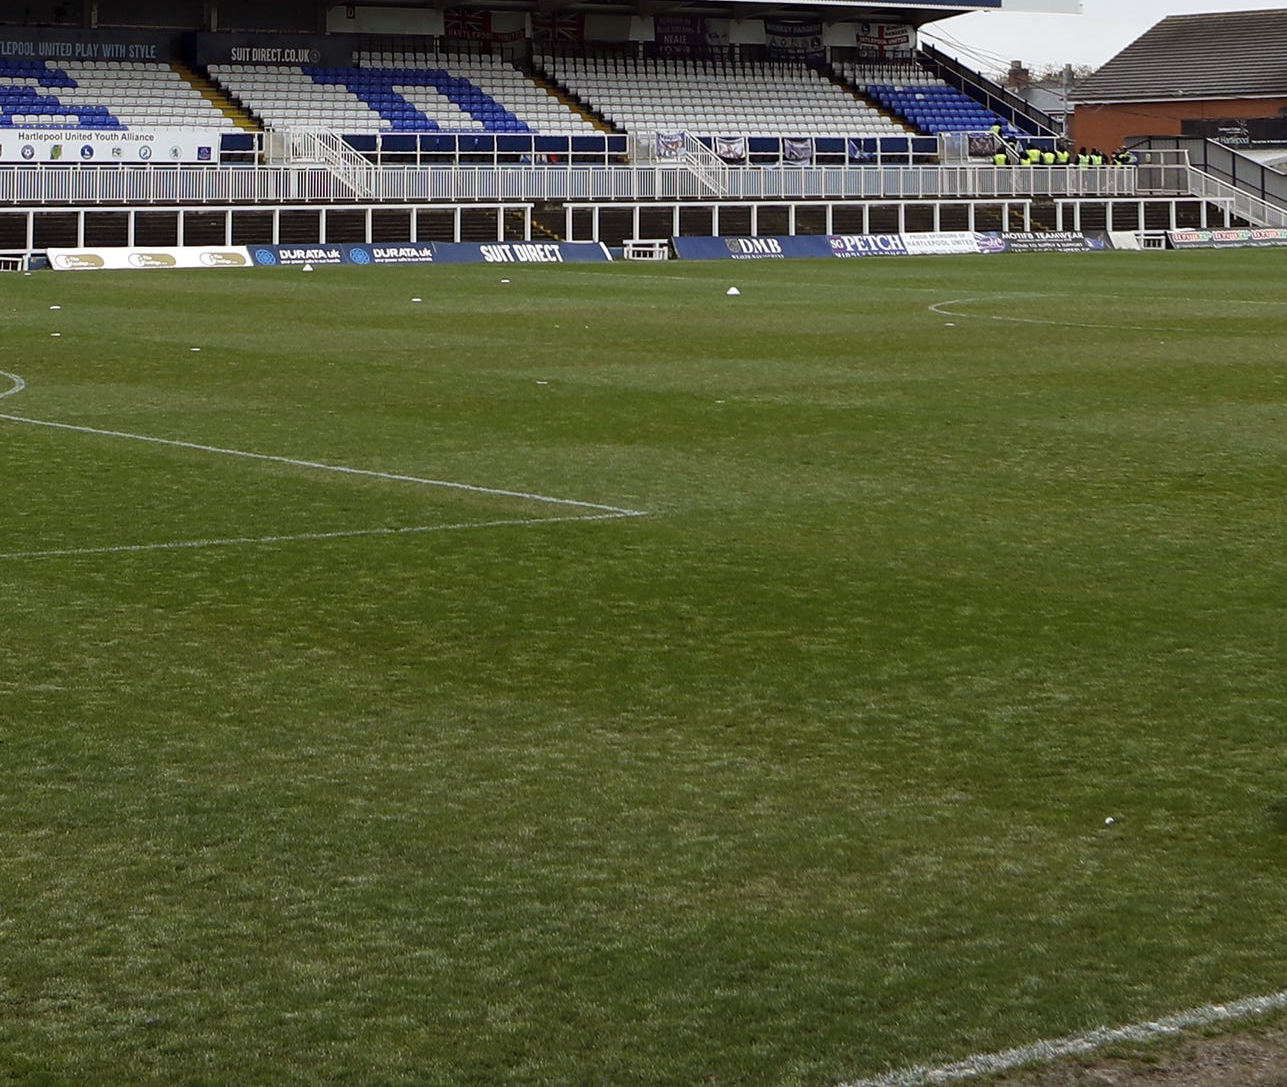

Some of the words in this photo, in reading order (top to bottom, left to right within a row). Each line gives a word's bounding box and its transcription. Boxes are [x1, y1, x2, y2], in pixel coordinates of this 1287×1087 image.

[38, 41, 73, 57] UNITED
[75, 43, 100, 58] PLAY
[101, 43, 126, 58] WITH
[128, 44, 156, 59] STYLE
[231, 47, 251, 62] SUIT
[252, 47, 310, 63] DIRECT.CO.UK
[18, 131, 62, 143] Hartlepool
[64, 131, 93, 142] United
[94, 132, 119, 142] Youth
[120, 132, 154, 142] Alliance
[738, 238, 782, 253] DMB
[830, 239, 842, 249] SG
[841, 234, 906, 252] PETCH
[279, 249, 327, 259] DURATA
[326, 248, 341, 258] uk
[373, 248, 420, 258] DURATA
[419, 247, 433, 257] uk
[479, 244, 513, 263] SUIT
[513, 244, 563, 262] DIRECT
